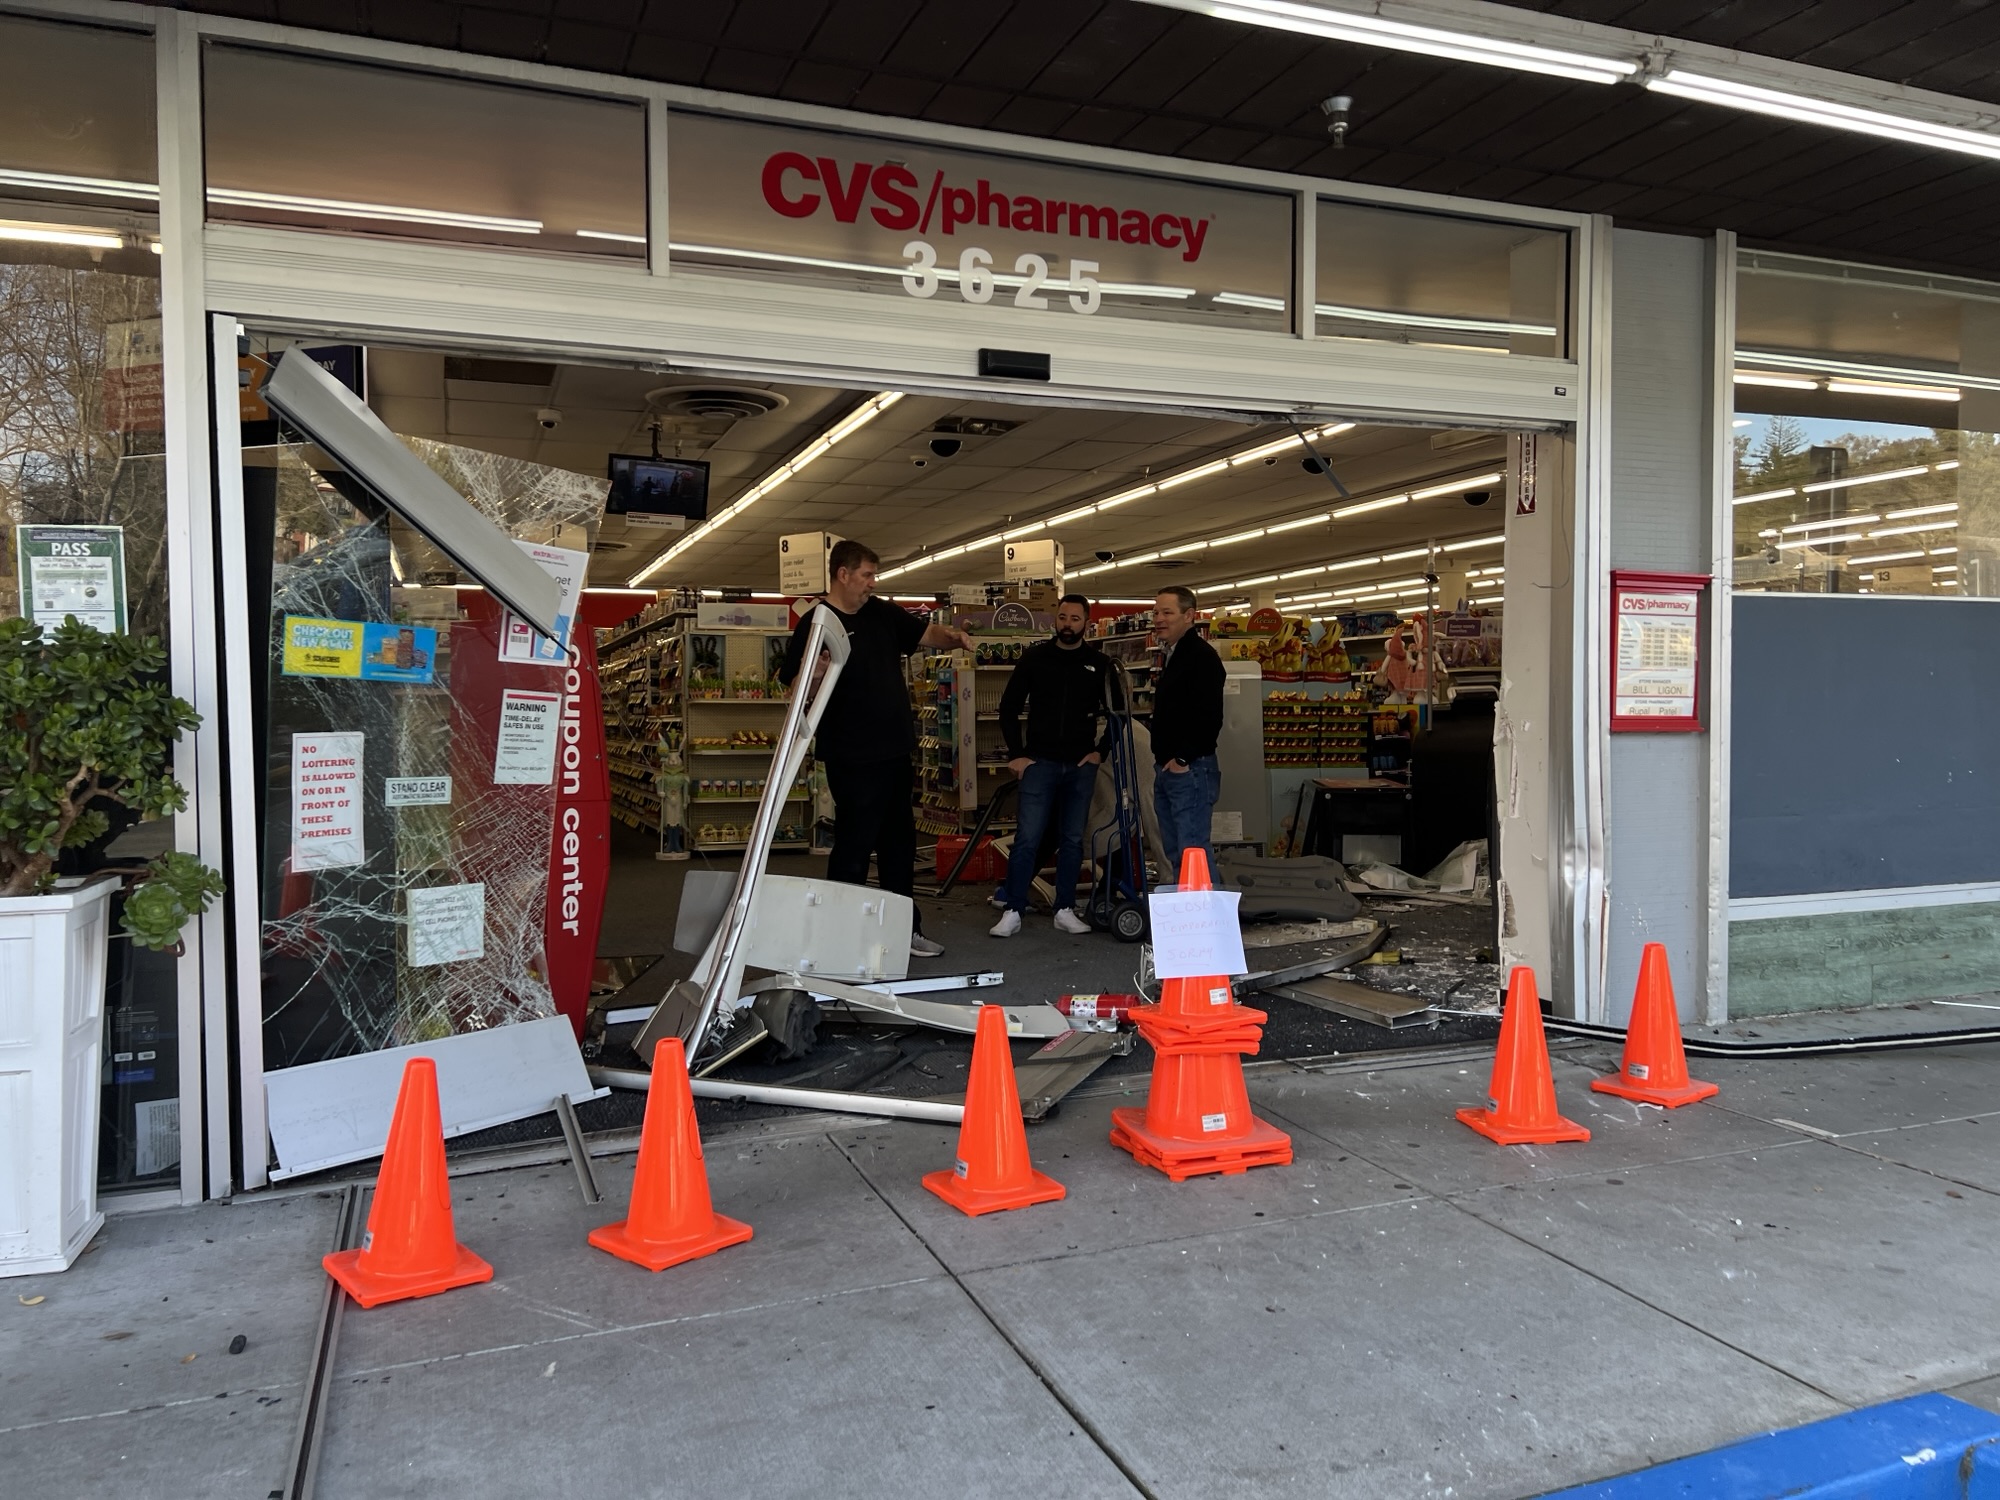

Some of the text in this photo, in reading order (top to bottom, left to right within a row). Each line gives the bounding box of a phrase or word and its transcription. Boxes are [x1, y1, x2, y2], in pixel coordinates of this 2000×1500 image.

[761, 151, 1210, 263] CVS/pharmacy
[902, 241, 1100, 315] 3625
[51, 542, 91, 556] PASS
[782, 540, 788, 552] 8
[1007, 548, 1014, 560] 9
[1878, 571, 1890, 581] 13
[1622, 598, 1690, 611] CVS/pharmacy
[998, 611, 1028, 624] Cadbury
[332, 629, 354, 640] OUT
[1633, 686, 1682, 694] BILL LIGON
[506, 702, 546, 712] WARNING
[1659, 707, 1677, 715] Patel
[302, 759, 355, 769] LOITERING
[302, 772, 356, 782] IS ALLOWED
[302, 786, 346, 796] ON OR IN
[391, 782, 446, 793] STAND CLEAR
[562, 644, 583, 937] coupon center
[301, 801, 335, 810] FRONT
[301, 815, 333, 824] THESE
[301, 828, 352, 838] PREMISES
